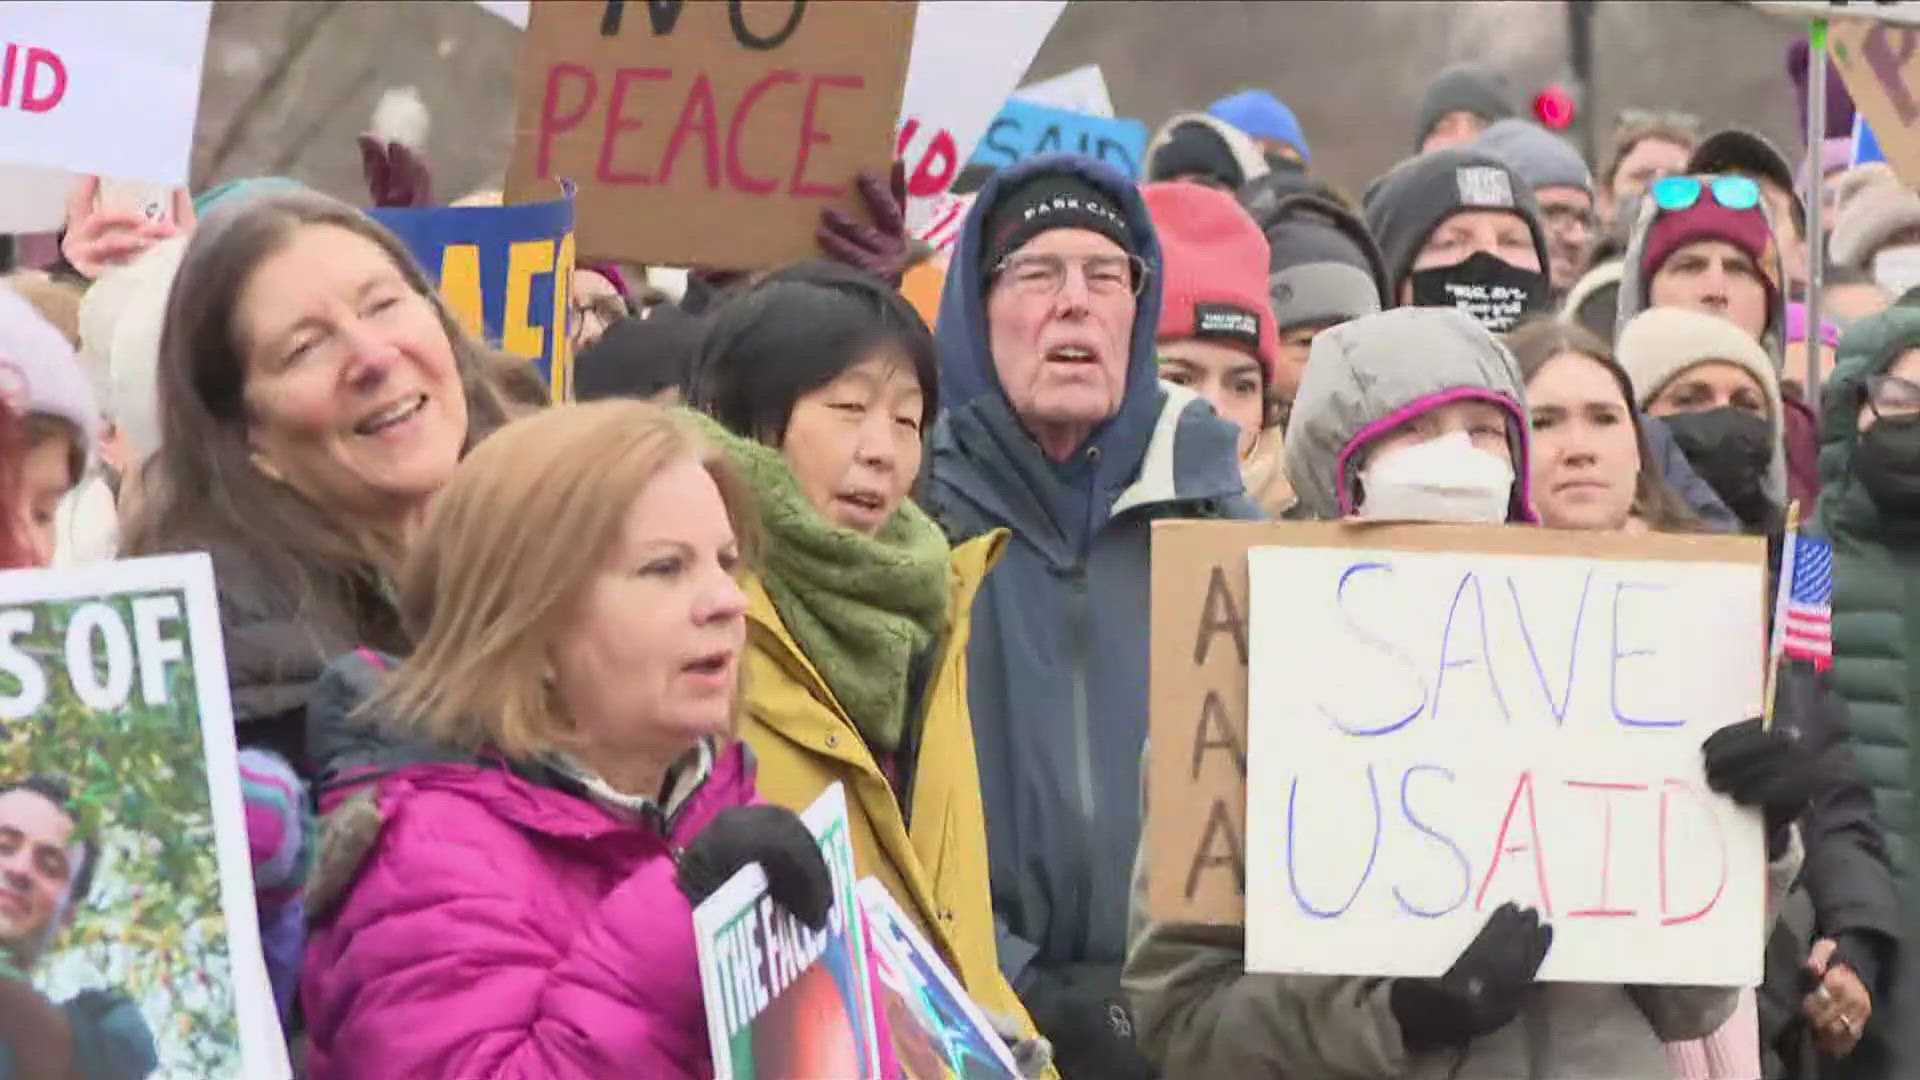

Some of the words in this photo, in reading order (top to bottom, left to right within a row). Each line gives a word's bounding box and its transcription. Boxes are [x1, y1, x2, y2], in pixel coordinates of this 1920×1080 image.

[536, 62, 865, 196] PEACE
[65, 597, 185, 711] OF
[1315, 562, 1688, 737] SAVE
[1287, 763, 1728, 927] USAID
[713, 902, 770, 1037] THE
